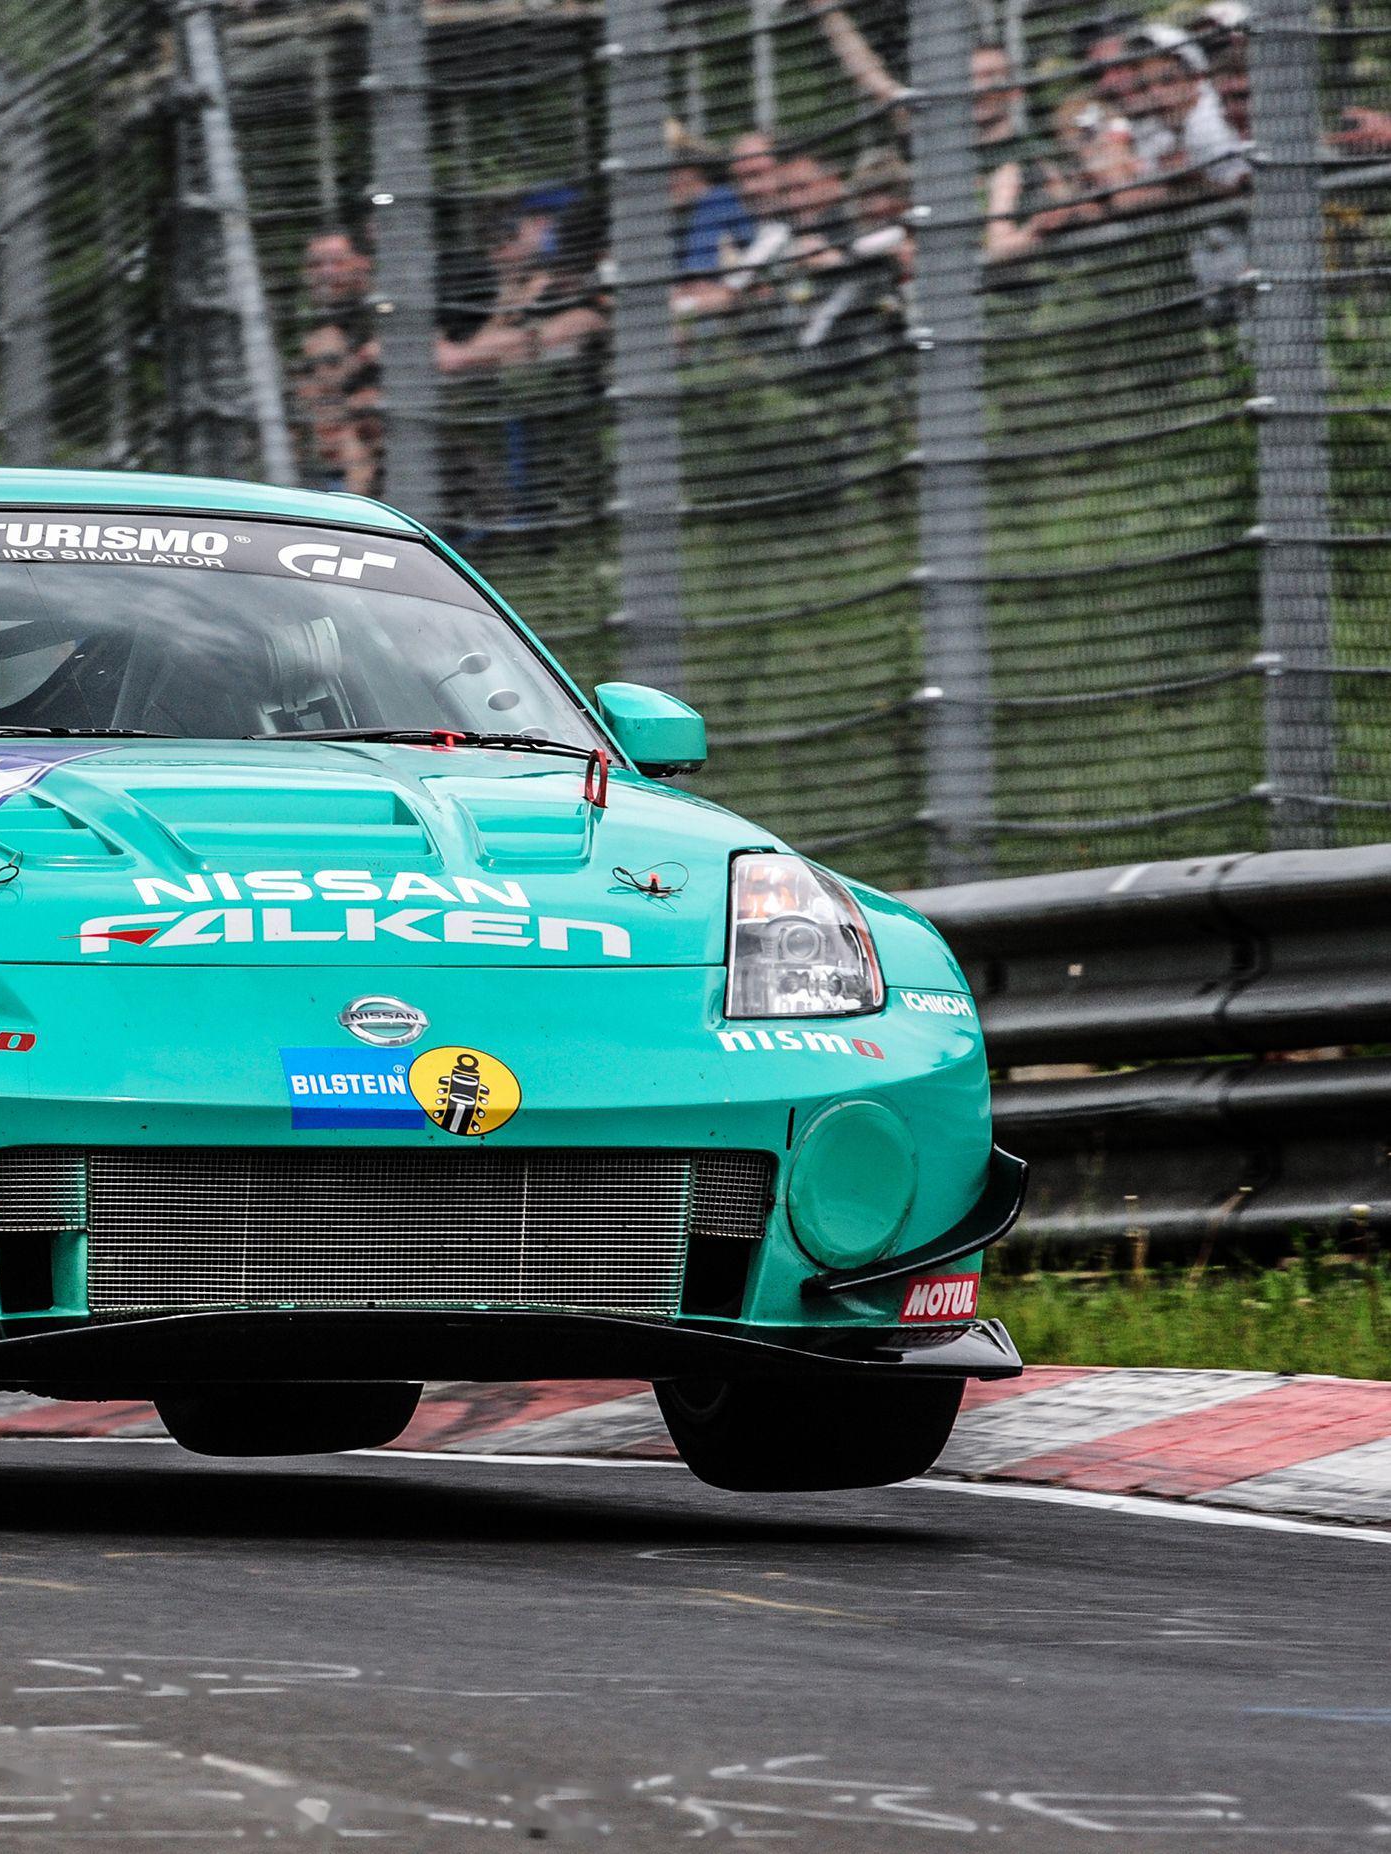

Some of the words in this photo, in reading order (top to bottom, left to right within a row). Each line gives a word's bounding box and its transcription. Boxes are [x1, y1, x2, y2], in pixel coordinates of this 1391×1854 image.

[59, 549, 226, 568] SIMULATOR
[131, 869, 532, 908] NISSAN
[62, 907, 632, 958] FALKEN
[350, 1011, 419, 1022] NISSAN
[900, 991, 975, 1018] ICHIKOH
[290, 1073, 408, 1096] BILSTEIN
[904, 1280, 975, 1317] MOTUL
